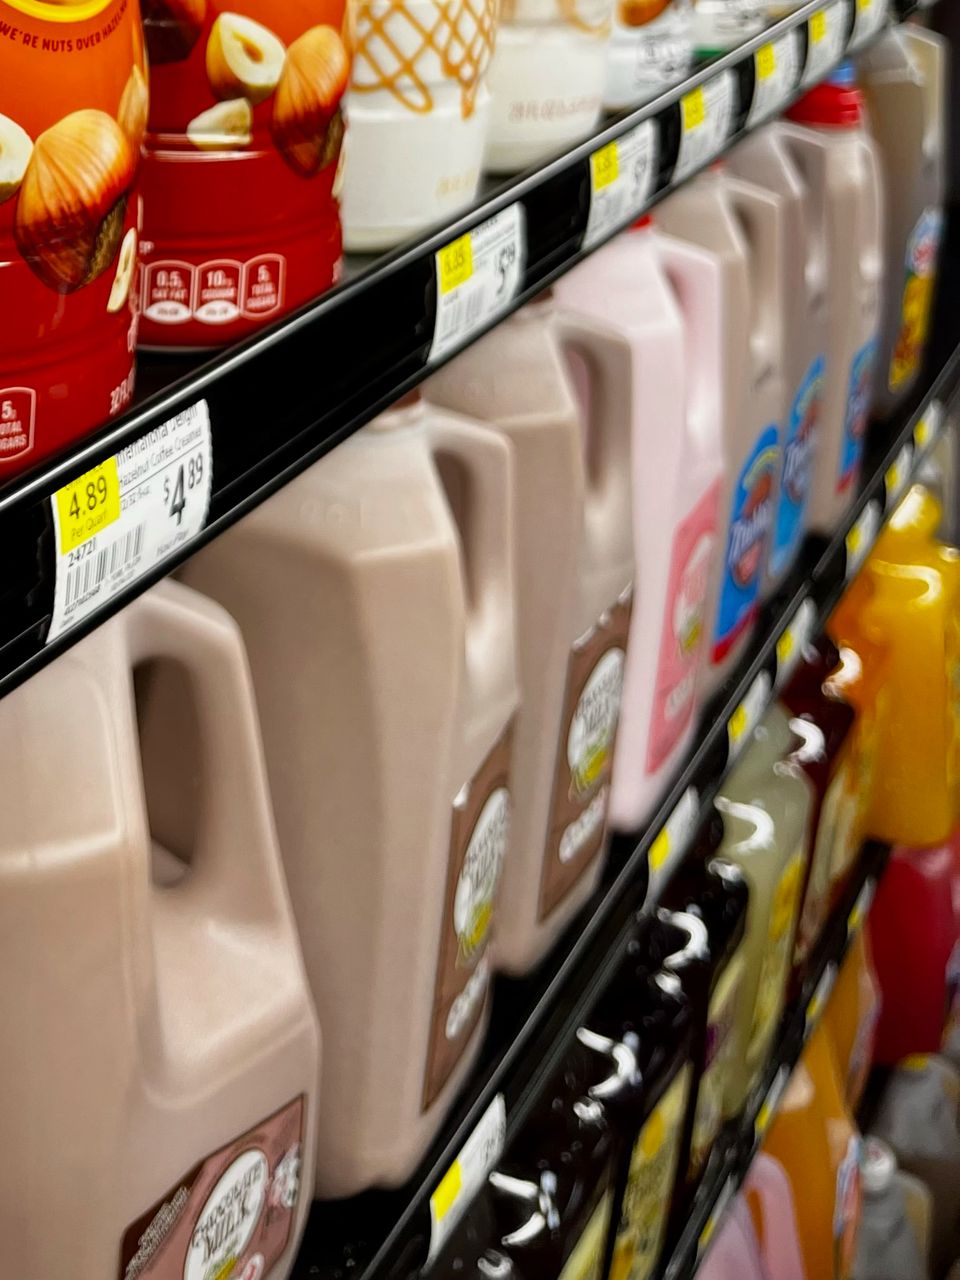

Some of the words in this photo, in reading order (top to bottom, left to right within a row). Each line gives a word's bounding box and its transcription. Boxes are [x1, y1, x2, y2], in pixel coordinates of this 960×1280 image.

[42, 38, 73, 52] NUTS
[76, 33, 101, 51] OVER
[120, 460, 150, 486] azelnut
[69, 474, 108, 520] 4.89
[71, 523, 85, 539] Per
[86, 510, 109, 533] Quart
